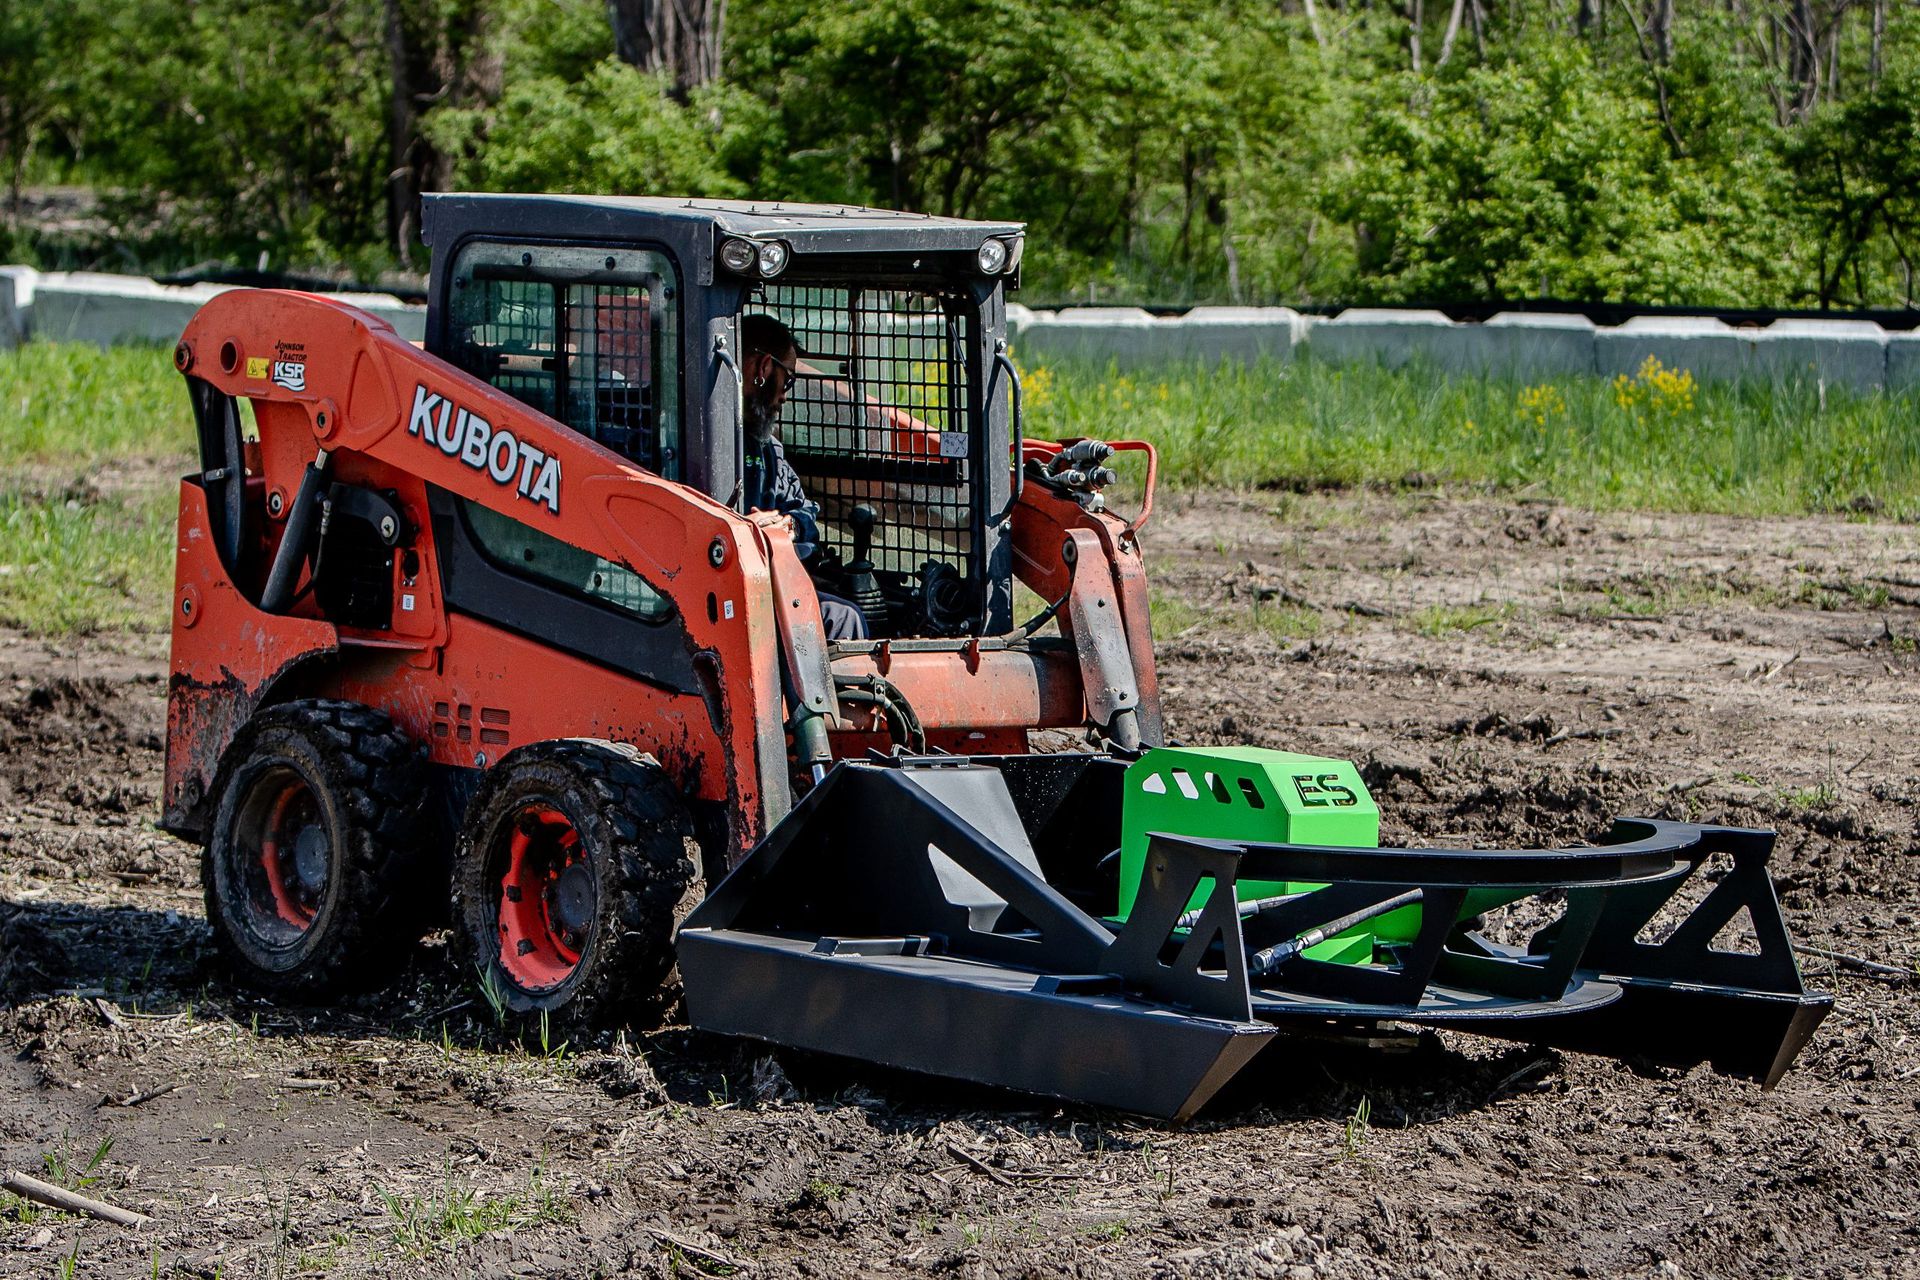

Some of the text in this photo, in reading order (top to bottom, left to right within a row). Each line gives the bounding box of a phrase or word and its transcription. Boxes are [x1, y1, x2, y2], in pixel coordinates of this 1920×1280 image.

[275, 339, 305, 351] JOHNSON
[274, 361, 305, 378] KSR
[408, 383, 561, 514] KUBOTA
[1291, 774, 1358, 807] ES
